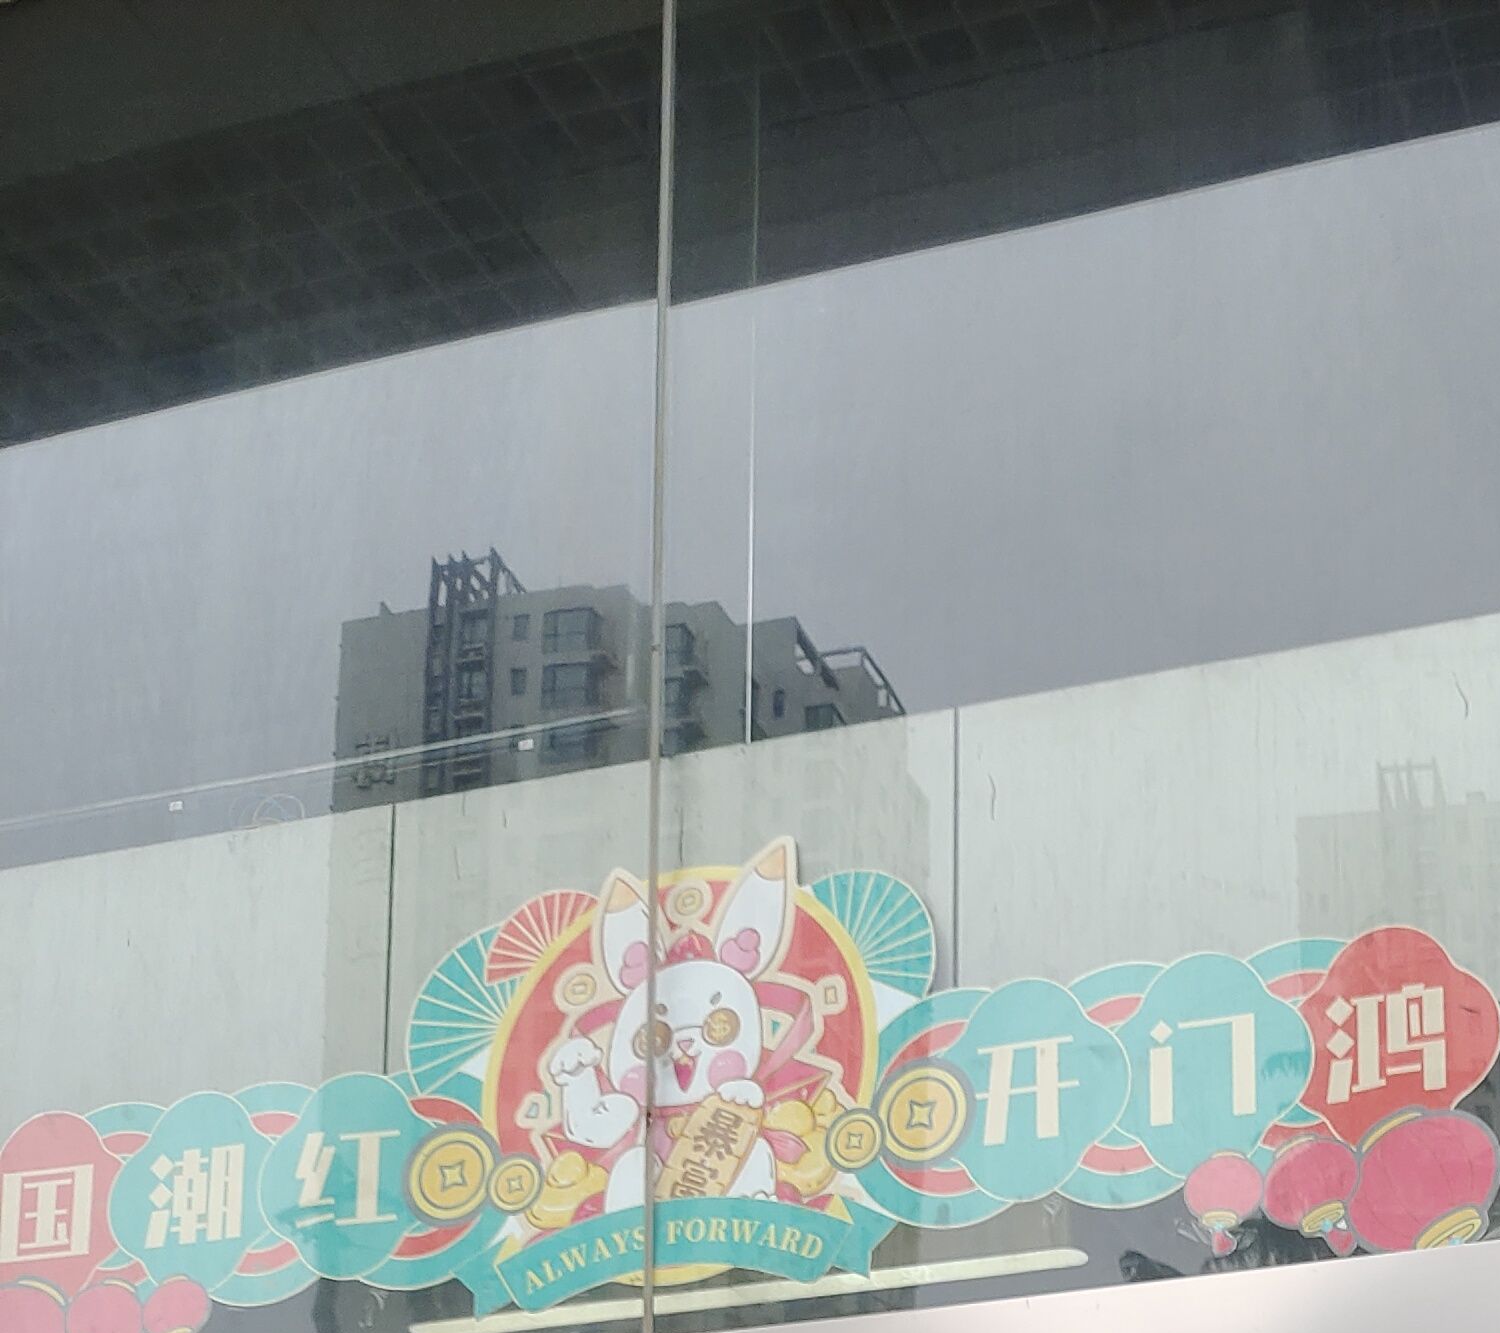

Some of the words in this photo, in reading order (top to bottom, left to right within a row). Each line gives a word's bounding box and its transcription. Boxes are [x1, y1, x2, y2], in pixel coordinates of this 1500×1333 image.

[2, 1130, 400, 1263] 国潮红
[975, 983, 1447, 1147] 开门鸿
[524, 1225, 646, 1295] ALWAYS
[665, 1218, 824, 1260] FORWARD
